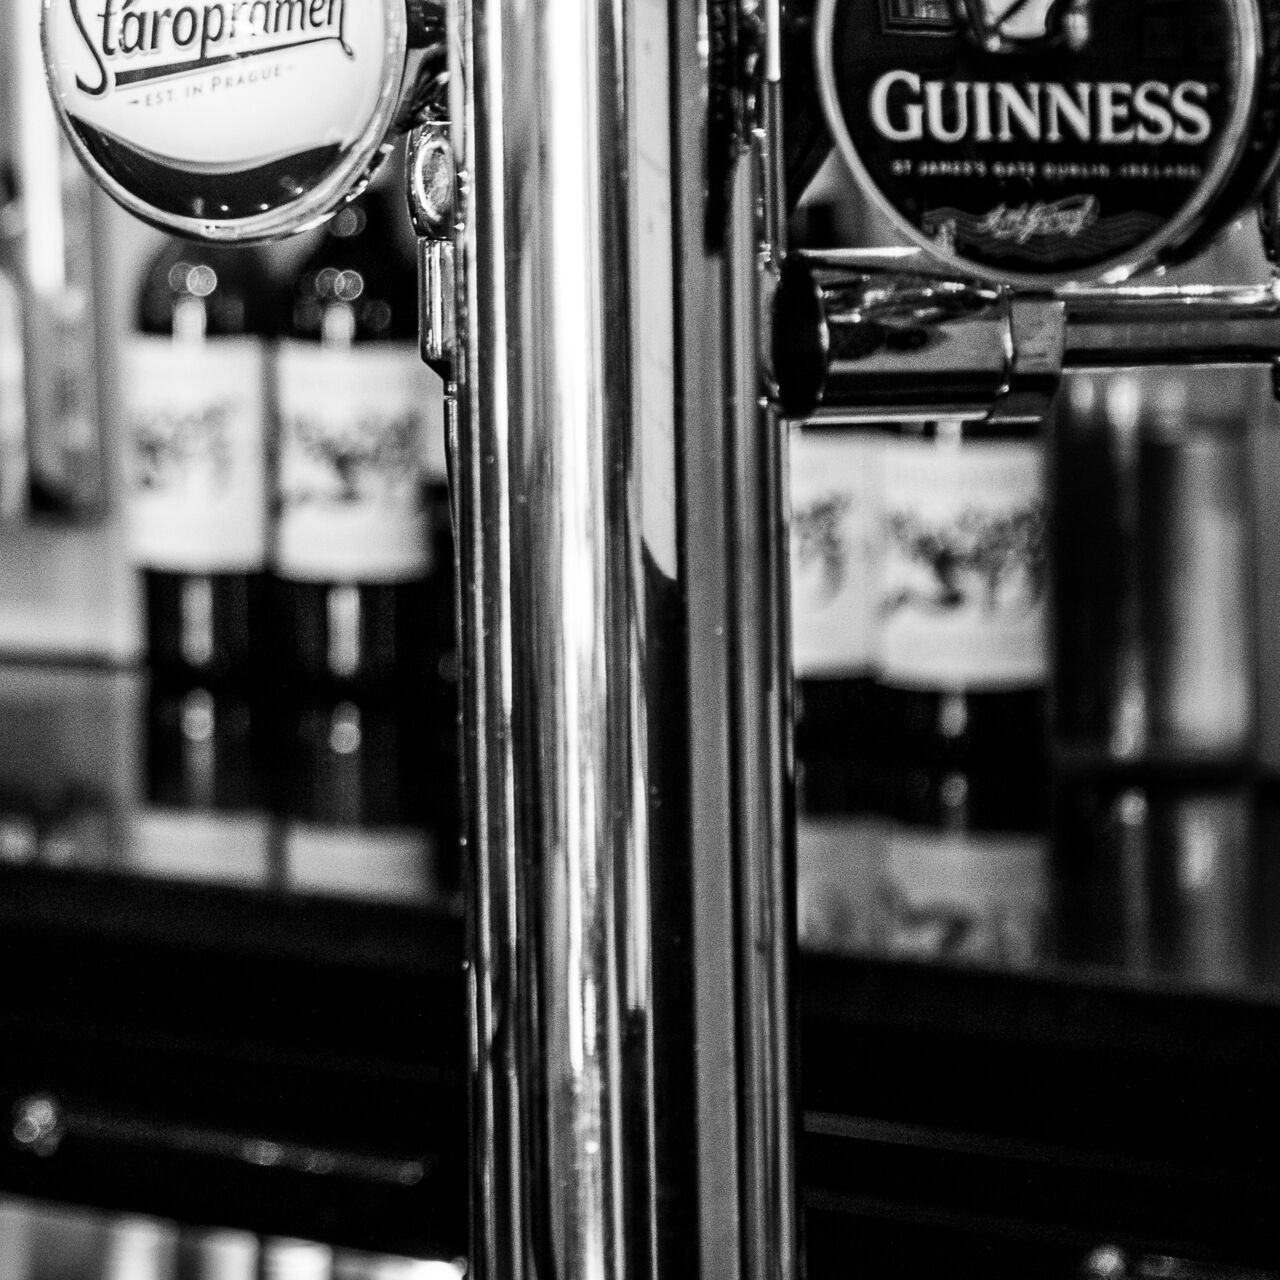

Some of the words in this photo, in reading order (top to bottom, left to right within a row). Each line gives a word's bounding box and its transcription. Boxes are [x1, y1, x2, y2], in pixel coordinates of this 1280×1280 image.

[186, 84, 203, 98] IN
[211, 65, 281, 92] PRAGUE
[869, 69, 1212, 144] GUINNESS
